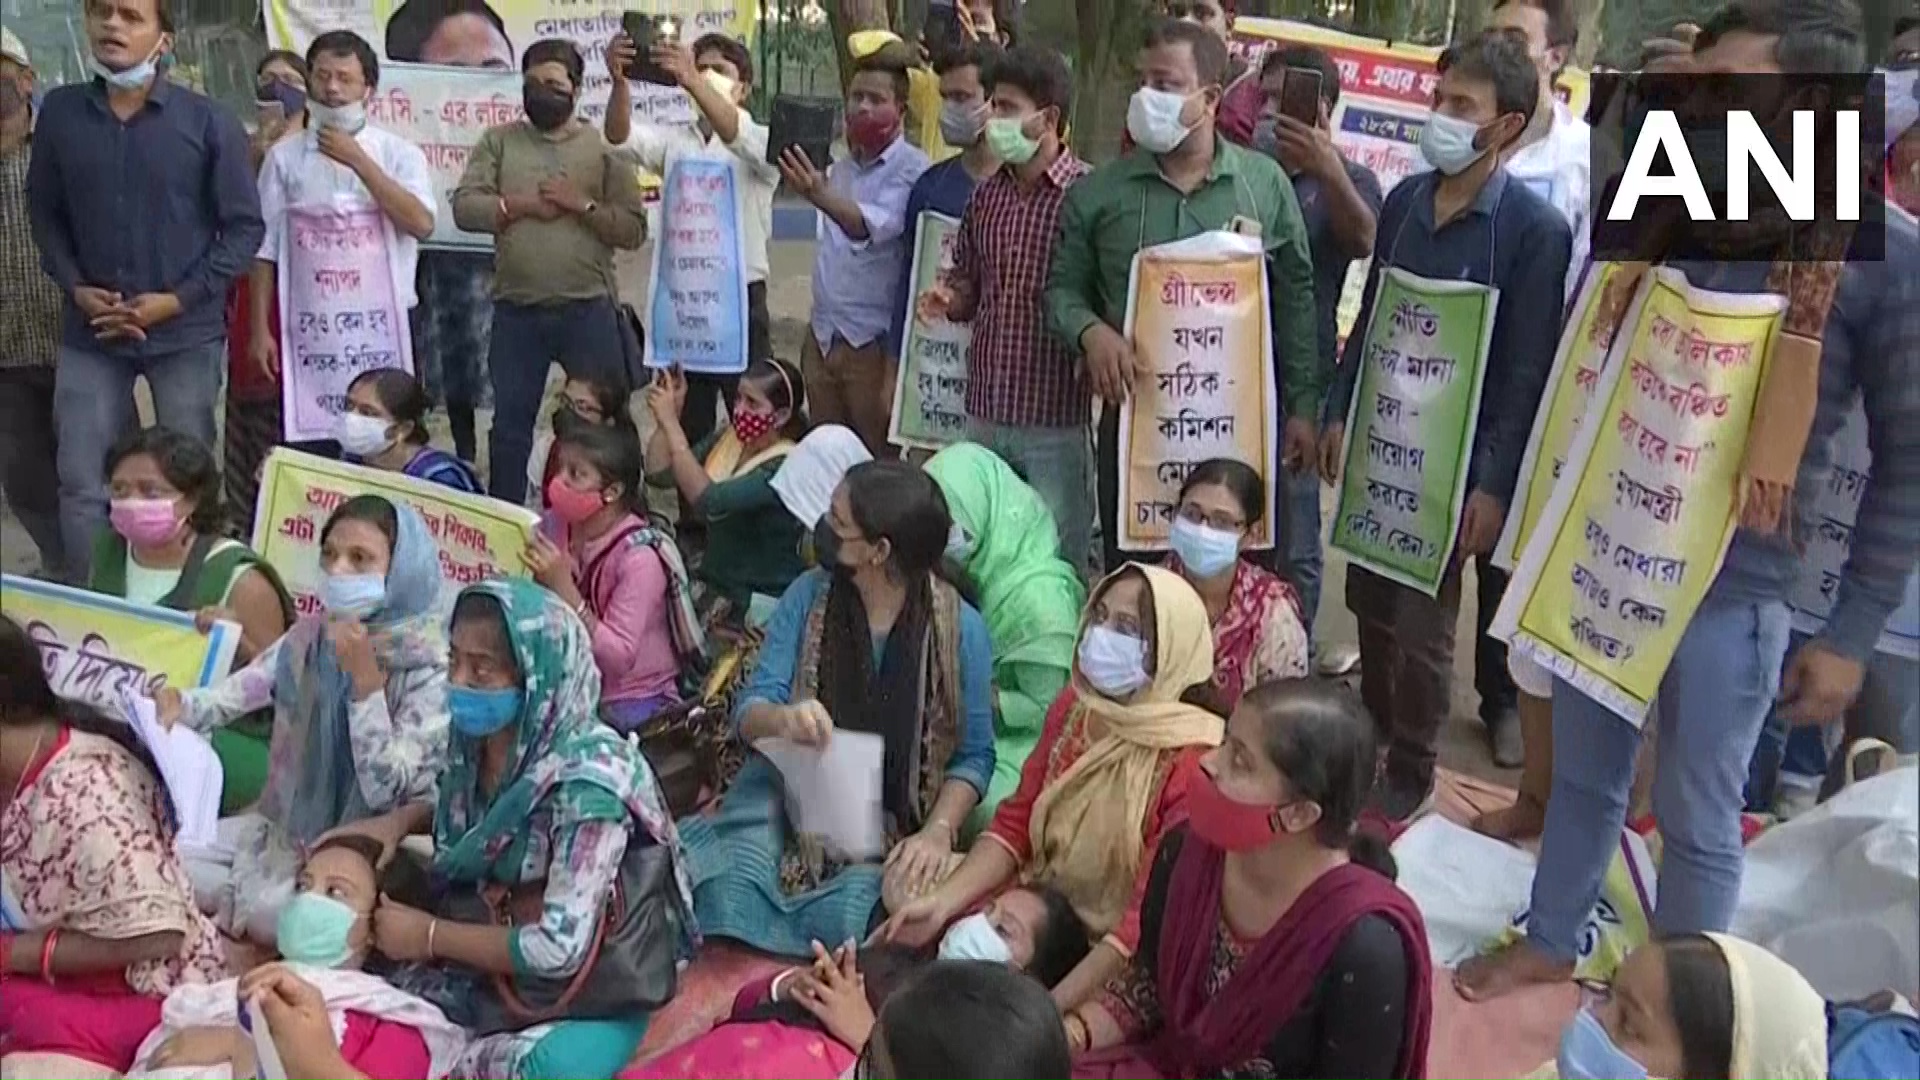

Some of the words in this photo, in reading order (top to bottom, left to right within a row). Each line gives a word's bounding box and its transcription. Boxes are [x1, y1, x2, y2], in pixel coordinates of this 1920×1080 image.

[335, 311, 364, 334] কেন
[1171, 326, 1224, 351] যখন
[1157, 362, 1220, 399] সঠিক
[1157, 408, 1235, 442] কমিশন
[1365, 477, 1420, 513] করতে
[1614, 543, 1686, 586] মেধারা
[1619, 597, 1667, 627] কেন
